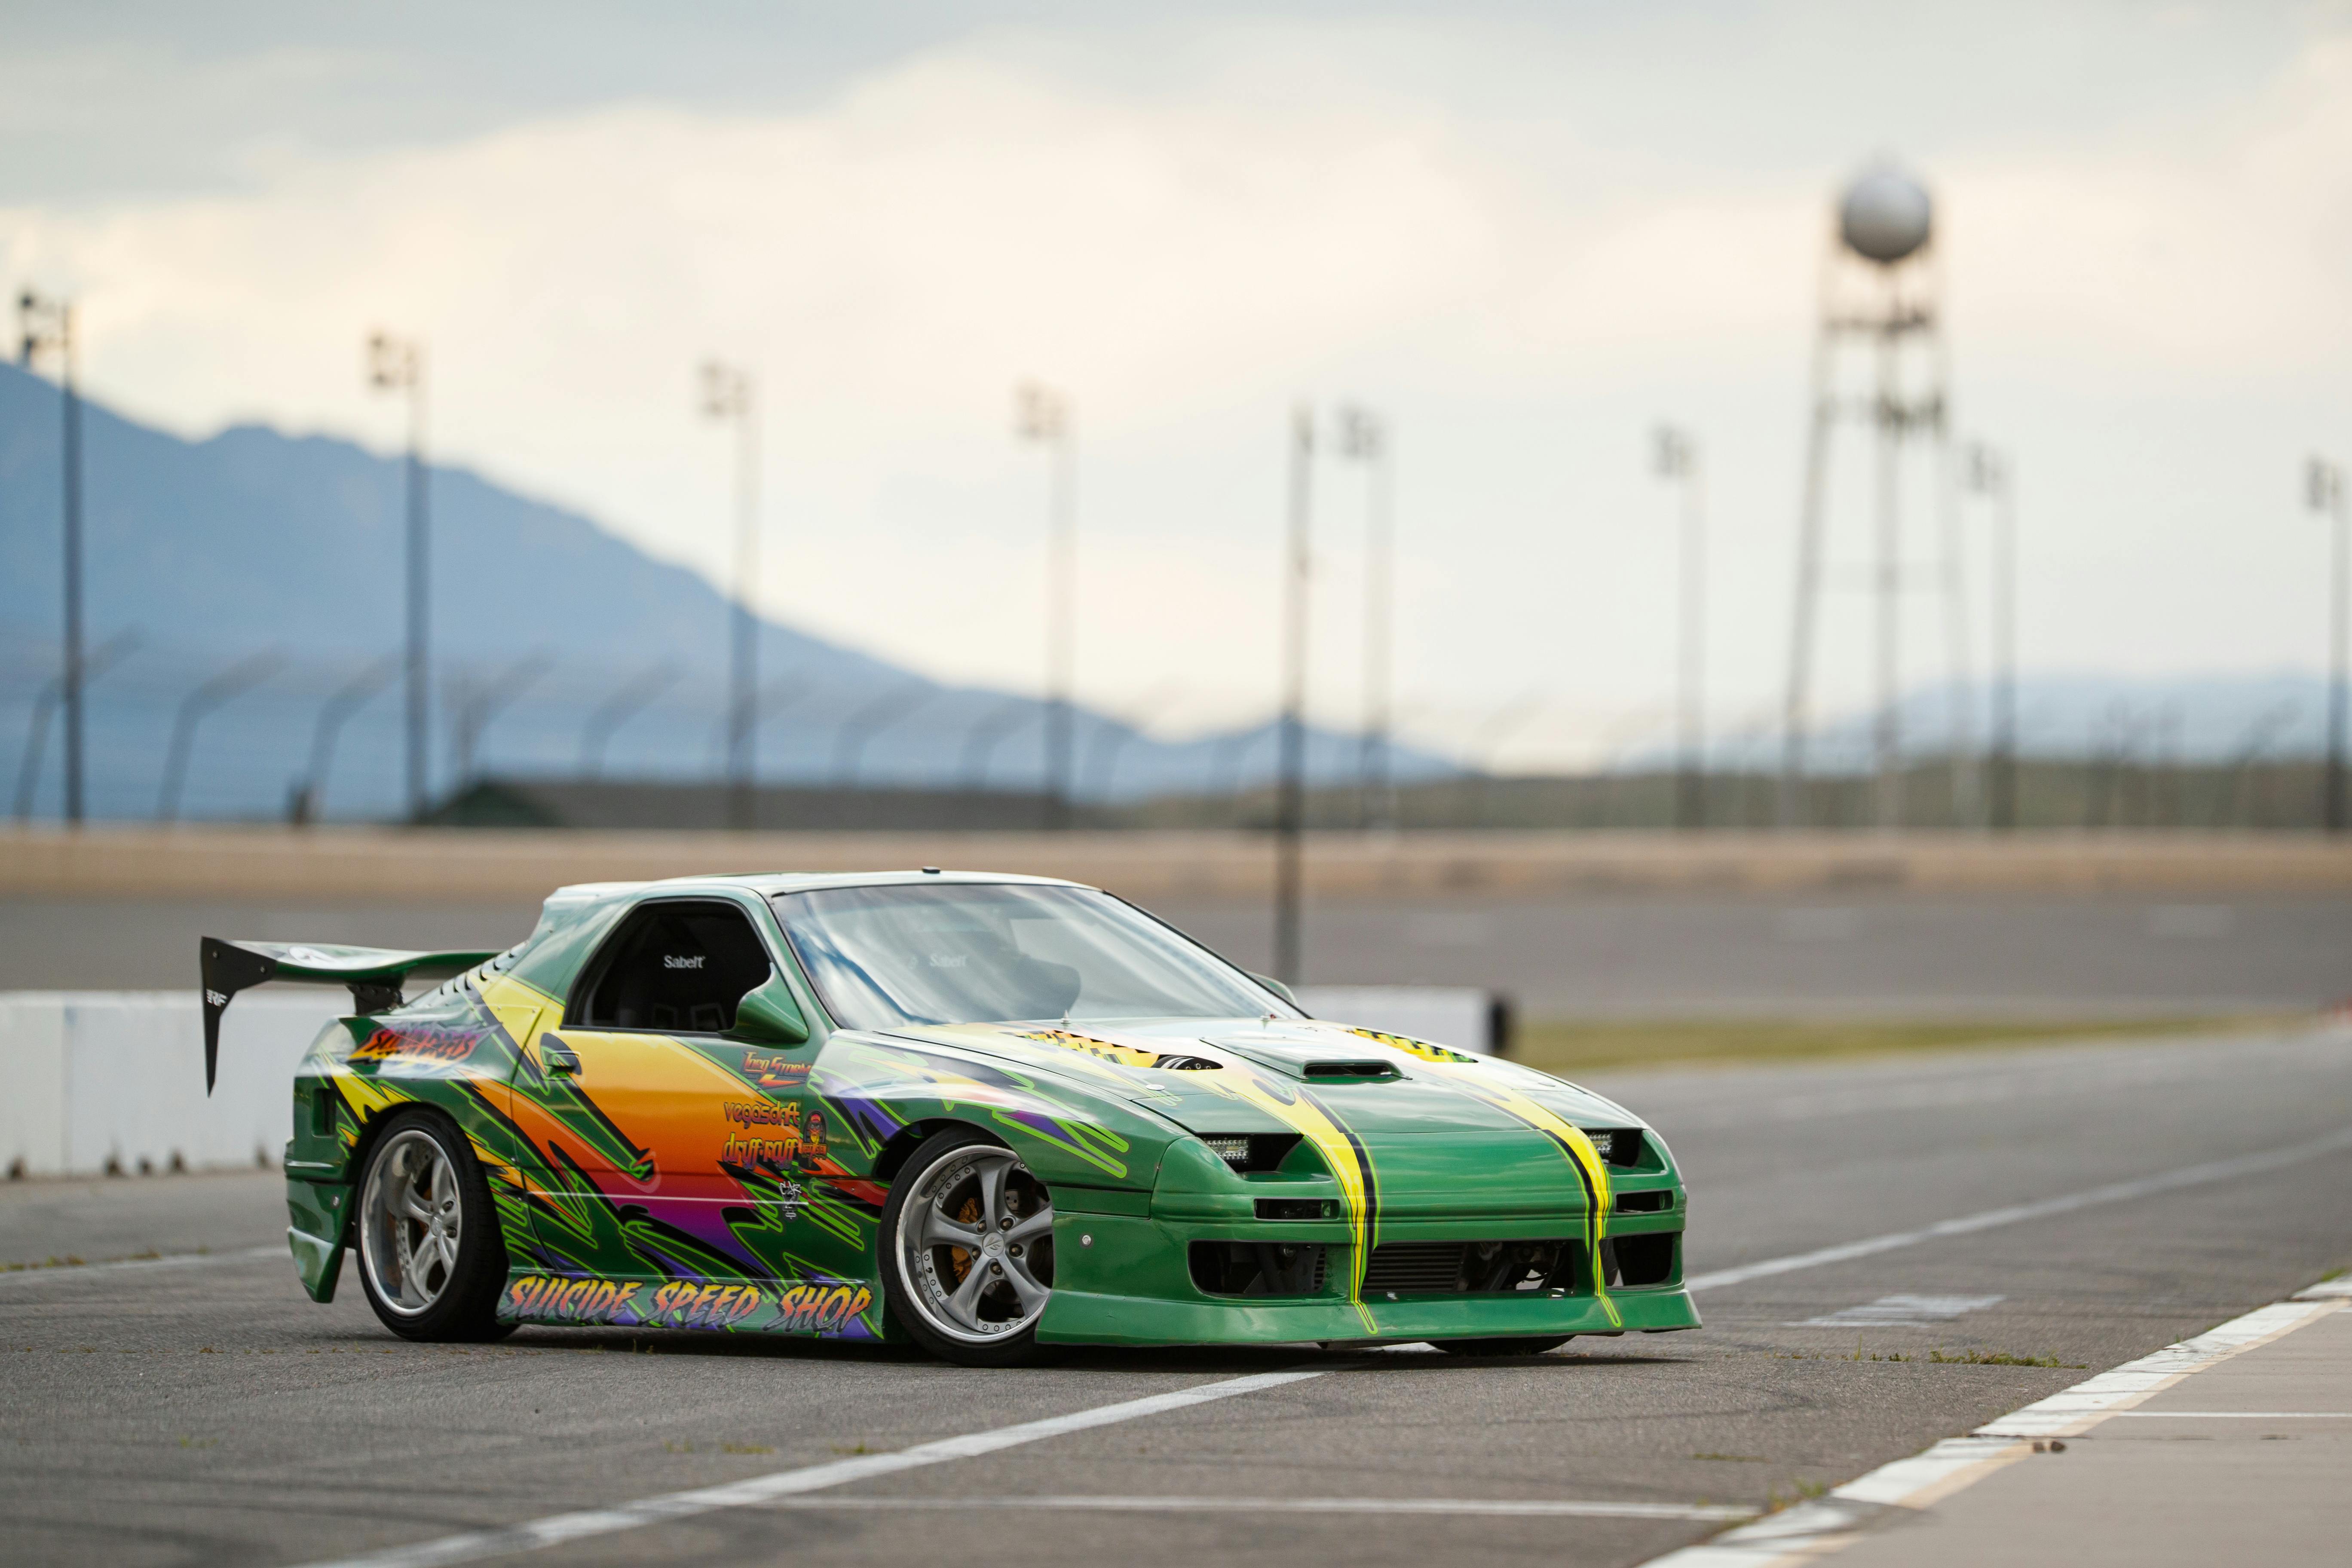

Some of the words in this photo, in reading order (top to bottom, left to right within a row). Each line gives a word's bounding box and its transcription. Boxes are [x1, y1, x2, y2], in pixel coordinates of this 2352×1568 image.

[664, 955, 706, 968] Sabelt
[496, 1274, 644, 1321] SUICIDE
[638, 1280, 762, 1327] SPEED
[763, 1284, 873, 1332] SHOP
